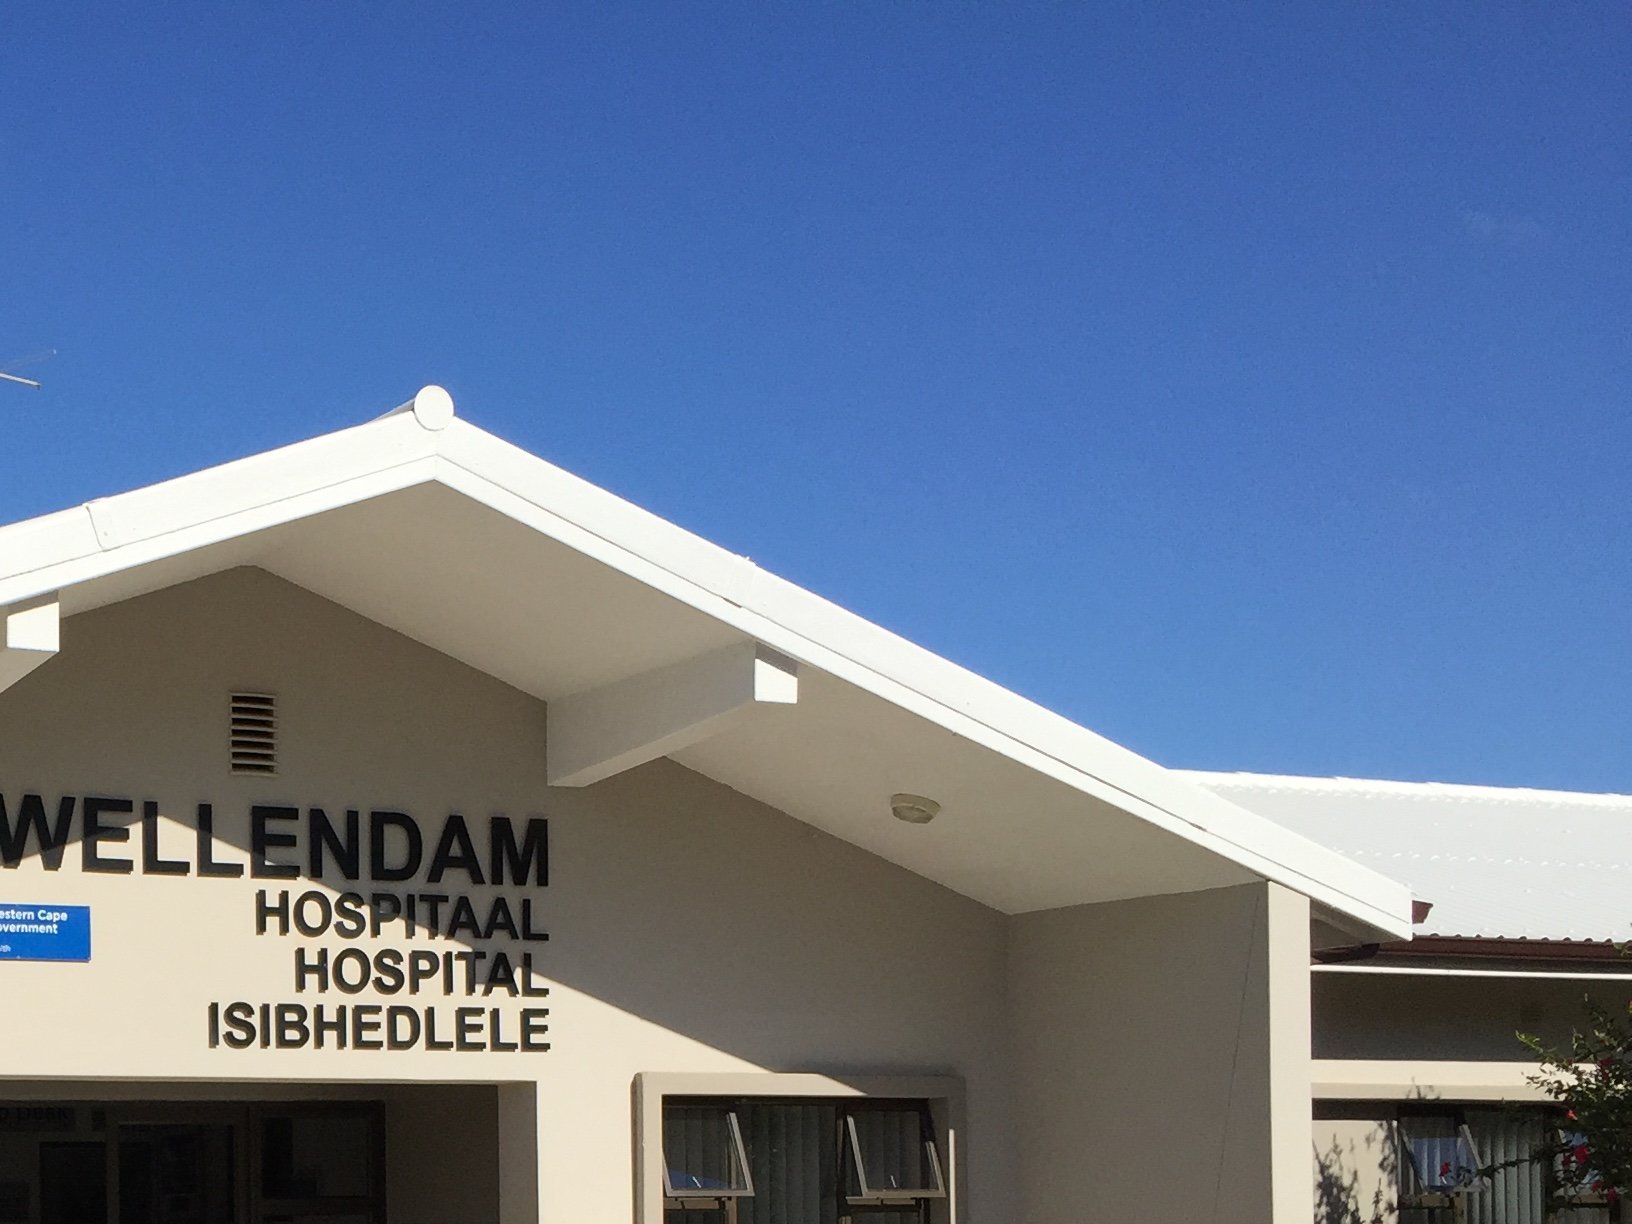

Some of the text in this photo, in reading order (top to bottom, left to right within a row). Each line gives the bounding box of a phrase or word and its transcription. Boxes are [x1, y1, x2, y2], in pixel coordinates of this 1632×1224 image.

[37, 910, 68, 922] Cape
[255, 889, 549, 942] HOSPITAAL
[294, 947, 550, 998] HOSPITAL
[208, 1001, 550, 1053] ISIBHEDLELE
